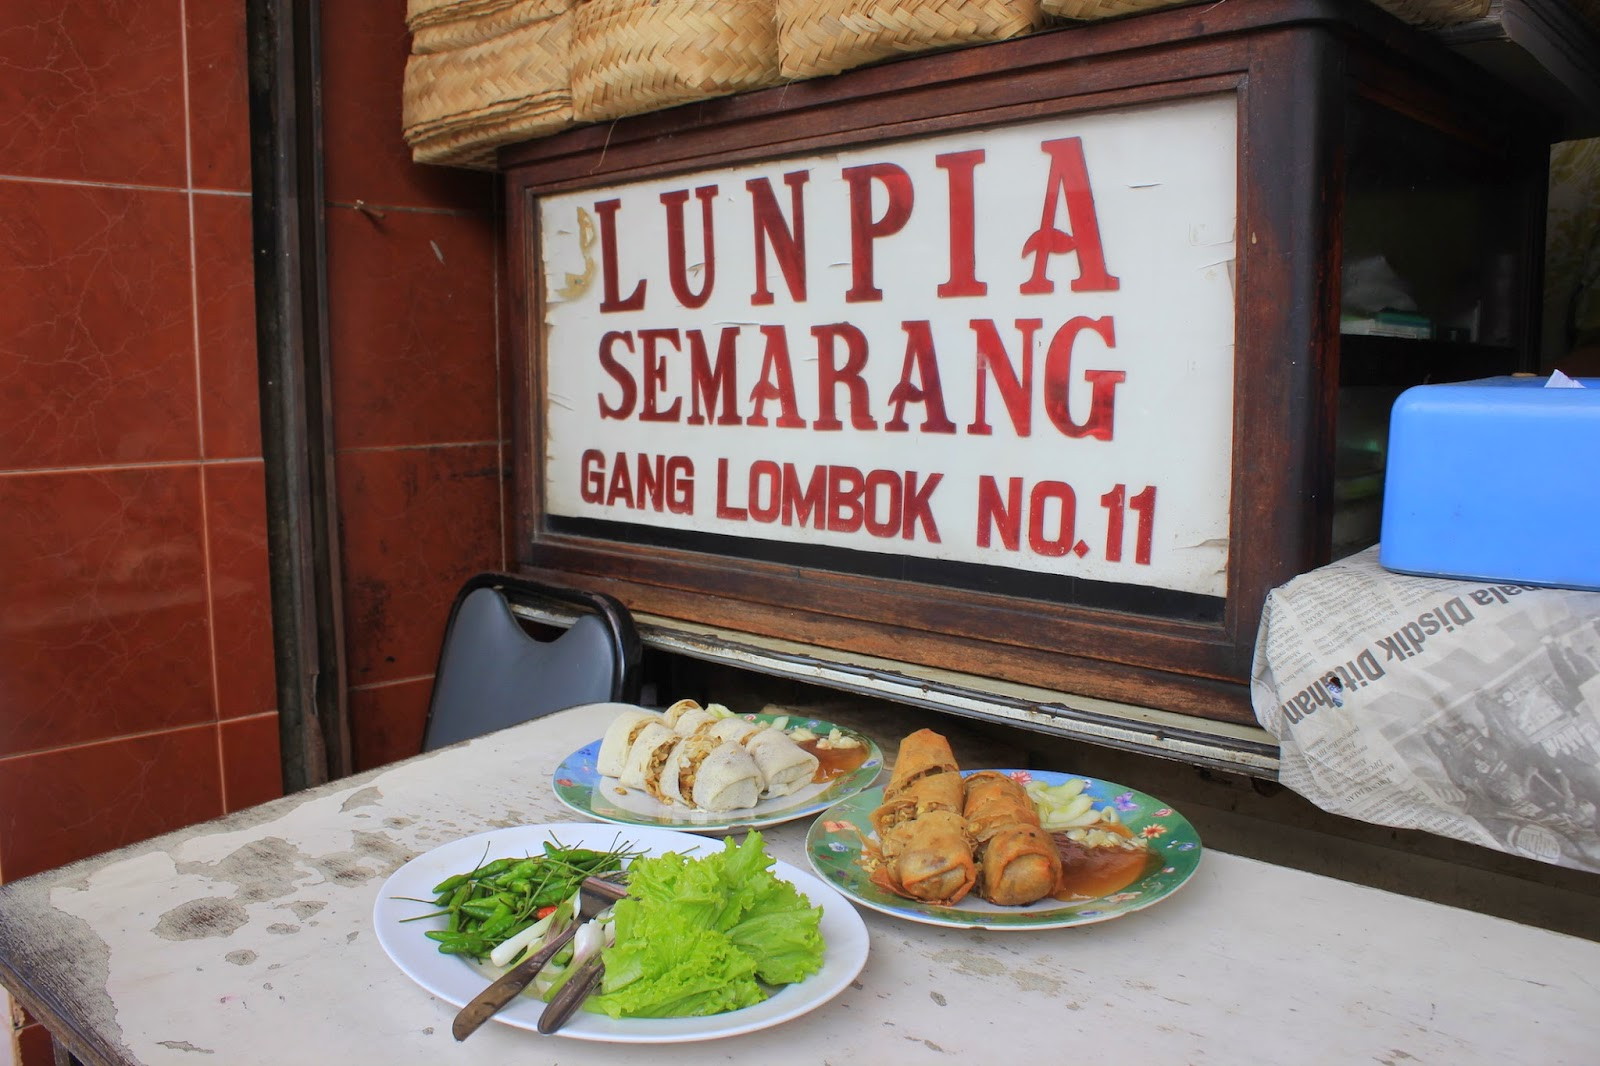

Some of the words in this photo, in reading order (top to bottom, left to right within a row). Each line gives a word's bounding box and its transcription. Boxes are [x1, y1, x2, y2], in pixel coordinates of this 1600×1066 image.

[595, 137, 1120, 313] LUNPIA
[598, 315, 1127, 442] SEMARANG
[581, 450, 695, 516] GANG
[716, 458, 944, 544] LOMBOK
[1374, 596, 1476, 662] Disdik
